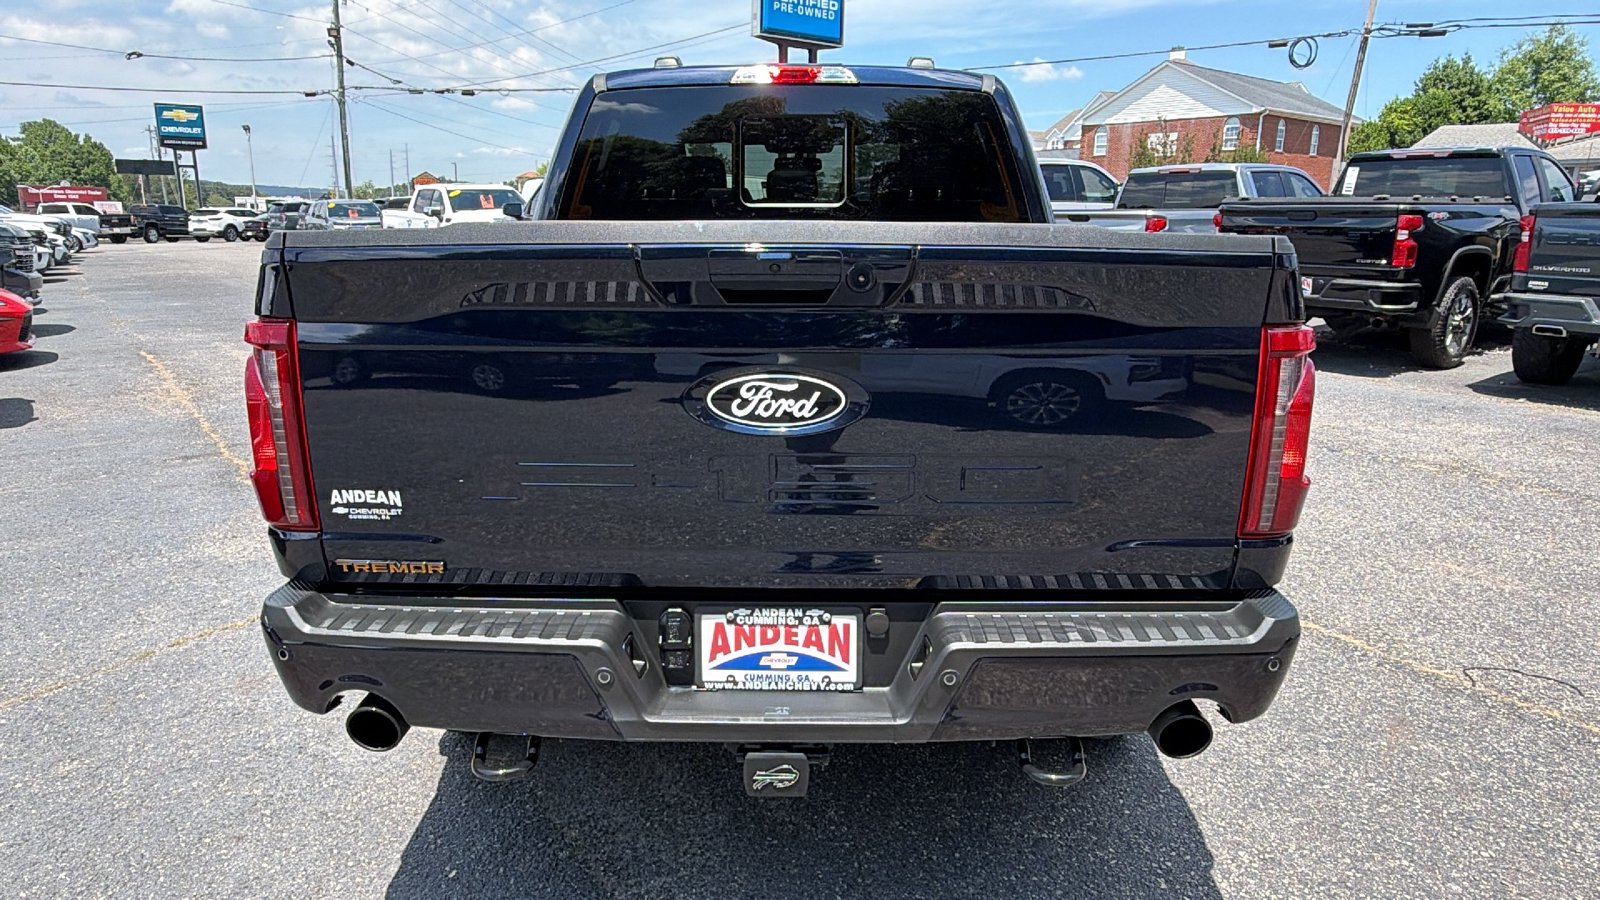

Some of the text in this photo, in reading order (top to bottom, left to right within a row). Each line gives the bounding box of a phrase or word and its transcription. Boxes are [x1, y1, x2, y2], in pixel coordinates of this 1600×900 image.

[780, 0, 838, 10] IFIED
[773, 1, 835, 20] PRE-OWNED
[1553, 105, 1597, 113] Value Auto
[161, 125, 202, 134] CHEVROLET
[1533, 265, 1591, 273] SILVERADO
[731, 381, 821, 418] Ford
[330, 489, 403, 507] ANDEAN
[349, 507, 403, 516] CHEVROLET
[335, 559, 445, 573] TREMOR
[753, 608, 803, 617] ANDEAN
[736, 616, 820, 625] CUMMING, GA
[708, 622, 850, 665] ANDEAN
[704, 681, 854, 691] www.ANDEANCHEVY.com
